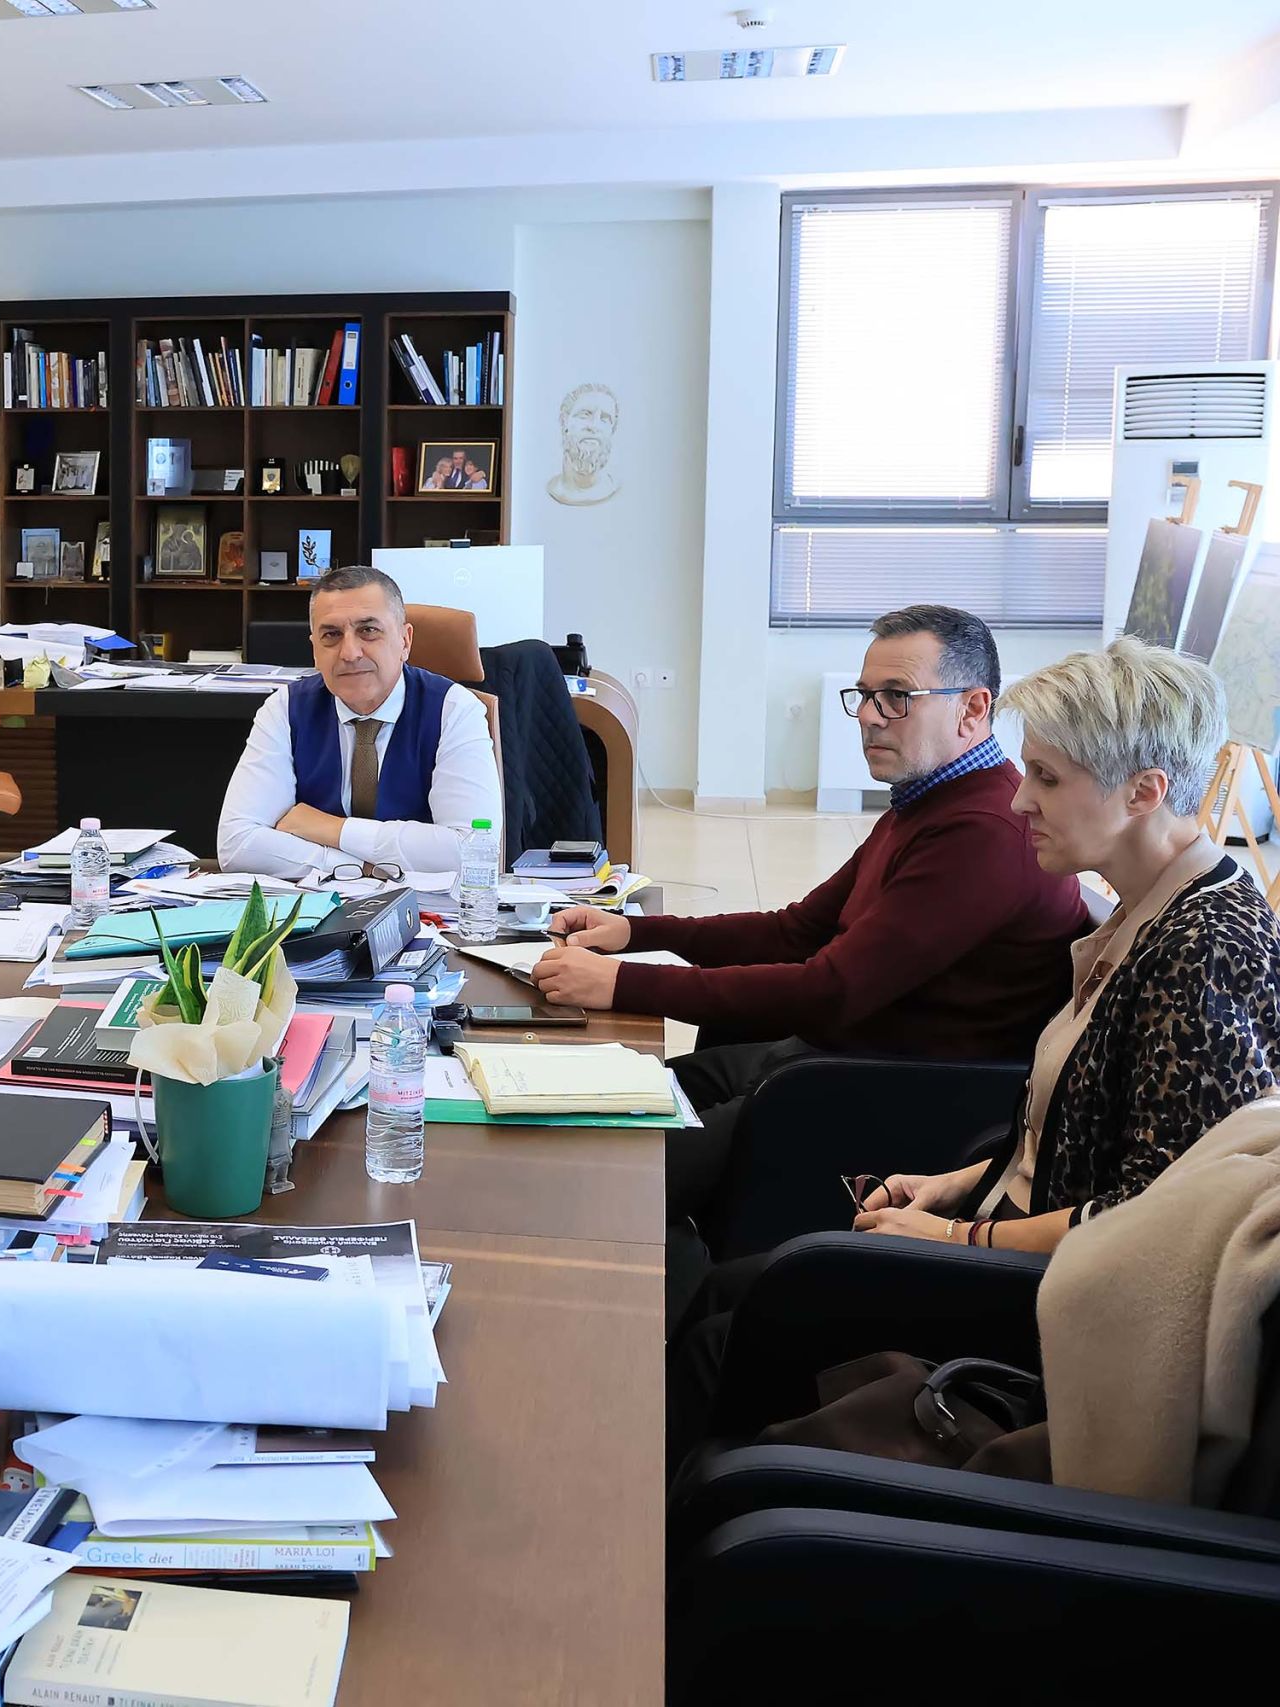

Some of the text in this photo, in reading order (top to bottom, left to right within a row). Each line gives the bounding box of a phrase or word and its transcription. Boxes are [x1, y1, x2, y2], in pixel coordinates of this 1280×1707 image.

[86, 1546, 145, 1564] Greek
[148, 1551, 174, 1564] diet
[274, 1546, 335, 1557] MARIA LOI
[32, 1687, 100, 1704] ALAIN RENAUT
